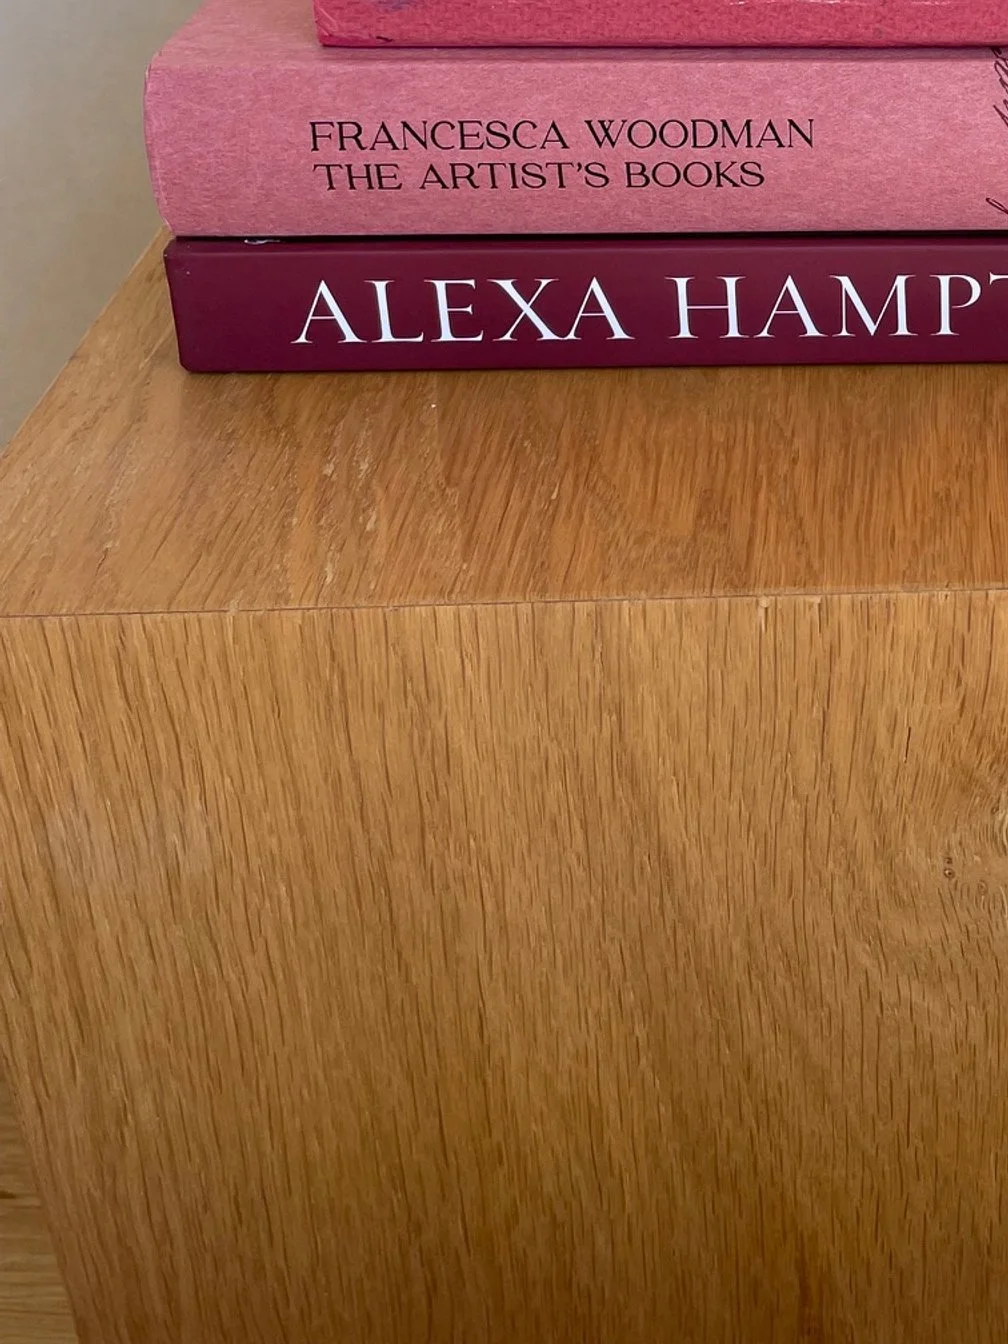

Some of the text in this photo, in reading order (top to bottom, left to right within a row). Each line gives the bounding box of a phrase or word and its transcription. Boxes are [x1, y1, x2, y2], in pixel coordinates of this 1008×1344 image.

[309, 118, 815, 152] FRANCESCA WOODMAN
[312, 161, 765, 191] THE ARTIST'S BOOKS
[291, 276, 635, 344] ALEXA
